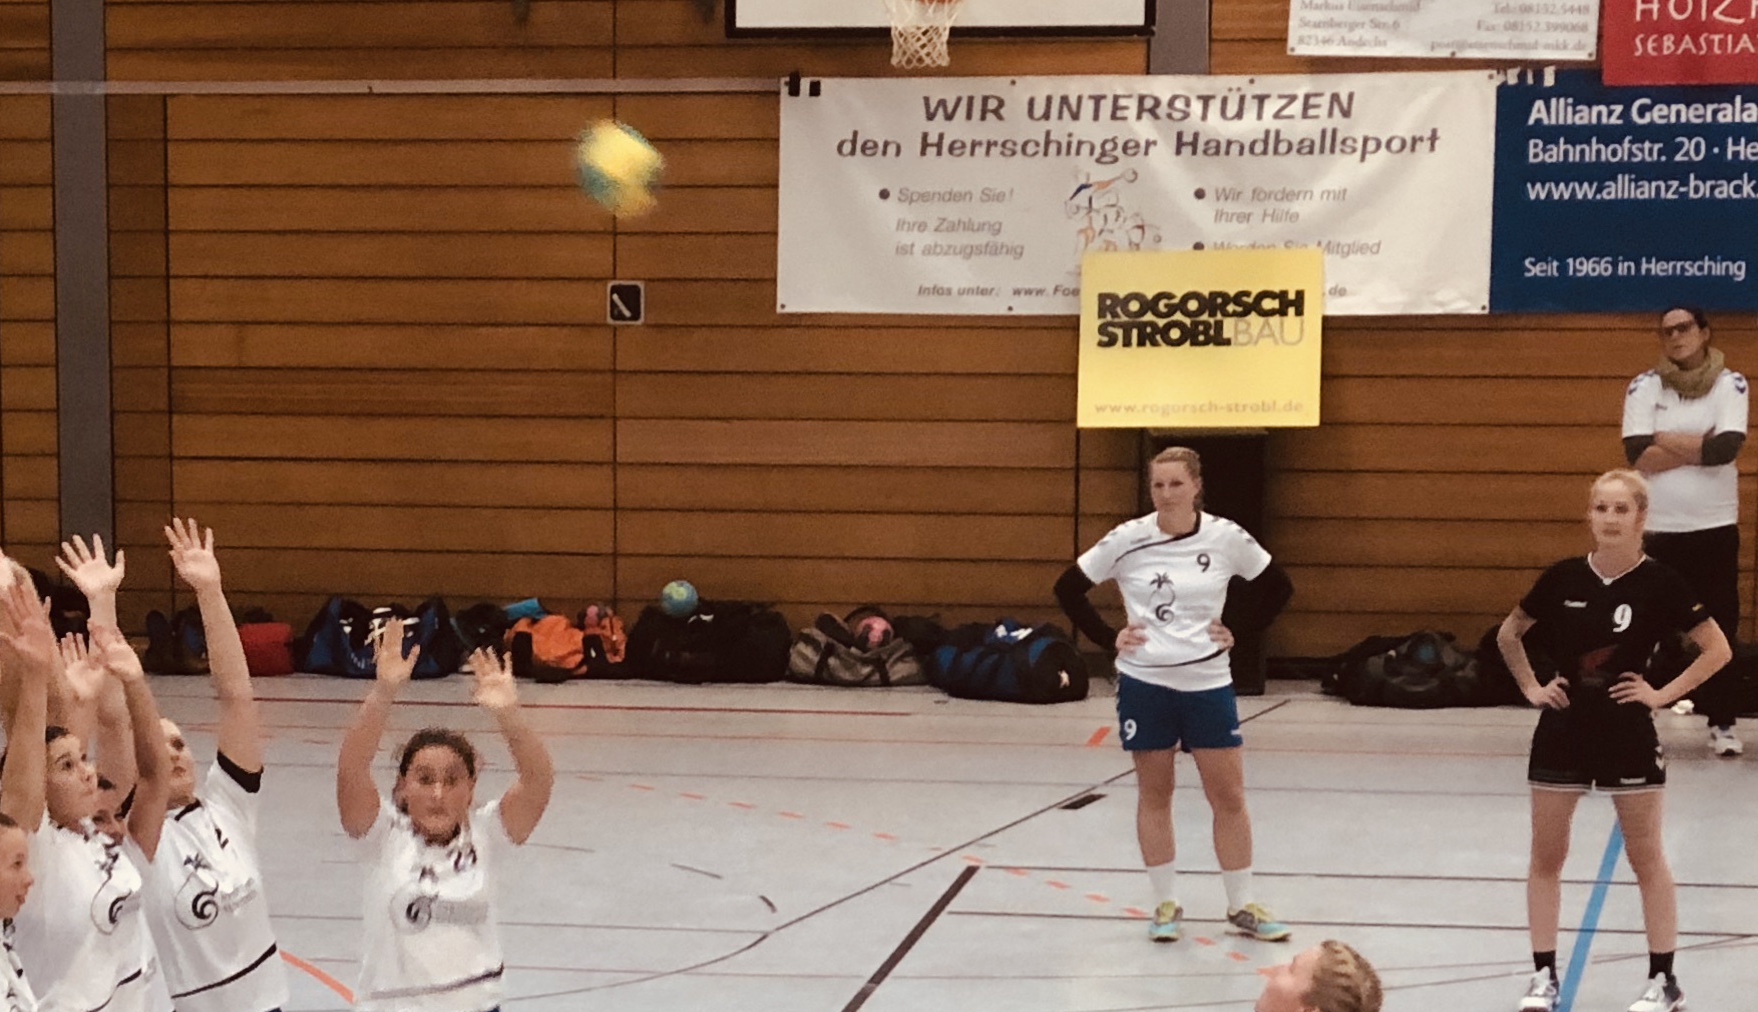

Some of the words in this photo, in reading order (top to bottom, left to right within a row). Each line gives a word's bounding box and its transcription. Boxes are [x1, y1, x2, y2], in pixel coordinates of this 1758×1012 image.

[1634, 33, 1758, 56] SEBASTIA
[922, 94, 1006, 122] WIR
[1027, 86, 1355, 122] UNTERSTÜTZEN
[1527, 97, 1624, 126] Allianz
[1631, 95, 1758, 125] Generala
[837, 130, 902, 157] den
[919, 129, 1158, 165] Herrschinger
[1175, 127, 1441, 163] Handballsport
[1528, 136, 1666, 164] Bahnhofstr.
[1674, 136, 1706, 163] 20
[1726, 136, 1758, 162] He
[897, 187, 973, 205] Spenden
[980, 187, 1014, 203] Sie!
[1214, 187, 1244, 201] Wir
[1320, 188, 1348, 201] mit
[895, 218, 928, 233] Ihre
[934, 218, 1003, 236] Zahlung
[1213, 208, 1254, 224] Ihrer
[1261, 208, 1300, 224] Hilfe
[895, 241, 915, 256] ist
[1524, 257, 1559, 277] Seit
[1565, 257, 1613, 277] 1966
[1617, 256, 1635, 276] in
[1641, 256, 1746, 282] Herrsching
[918, 285, 952, 296] Infos
[1097, 289, 1305, 320] ROGORSCH
[1197, 553, 1211, 573] 9
[1613, 603, 1633, 633] 9
[1124, 718, 1137, 741] 9
